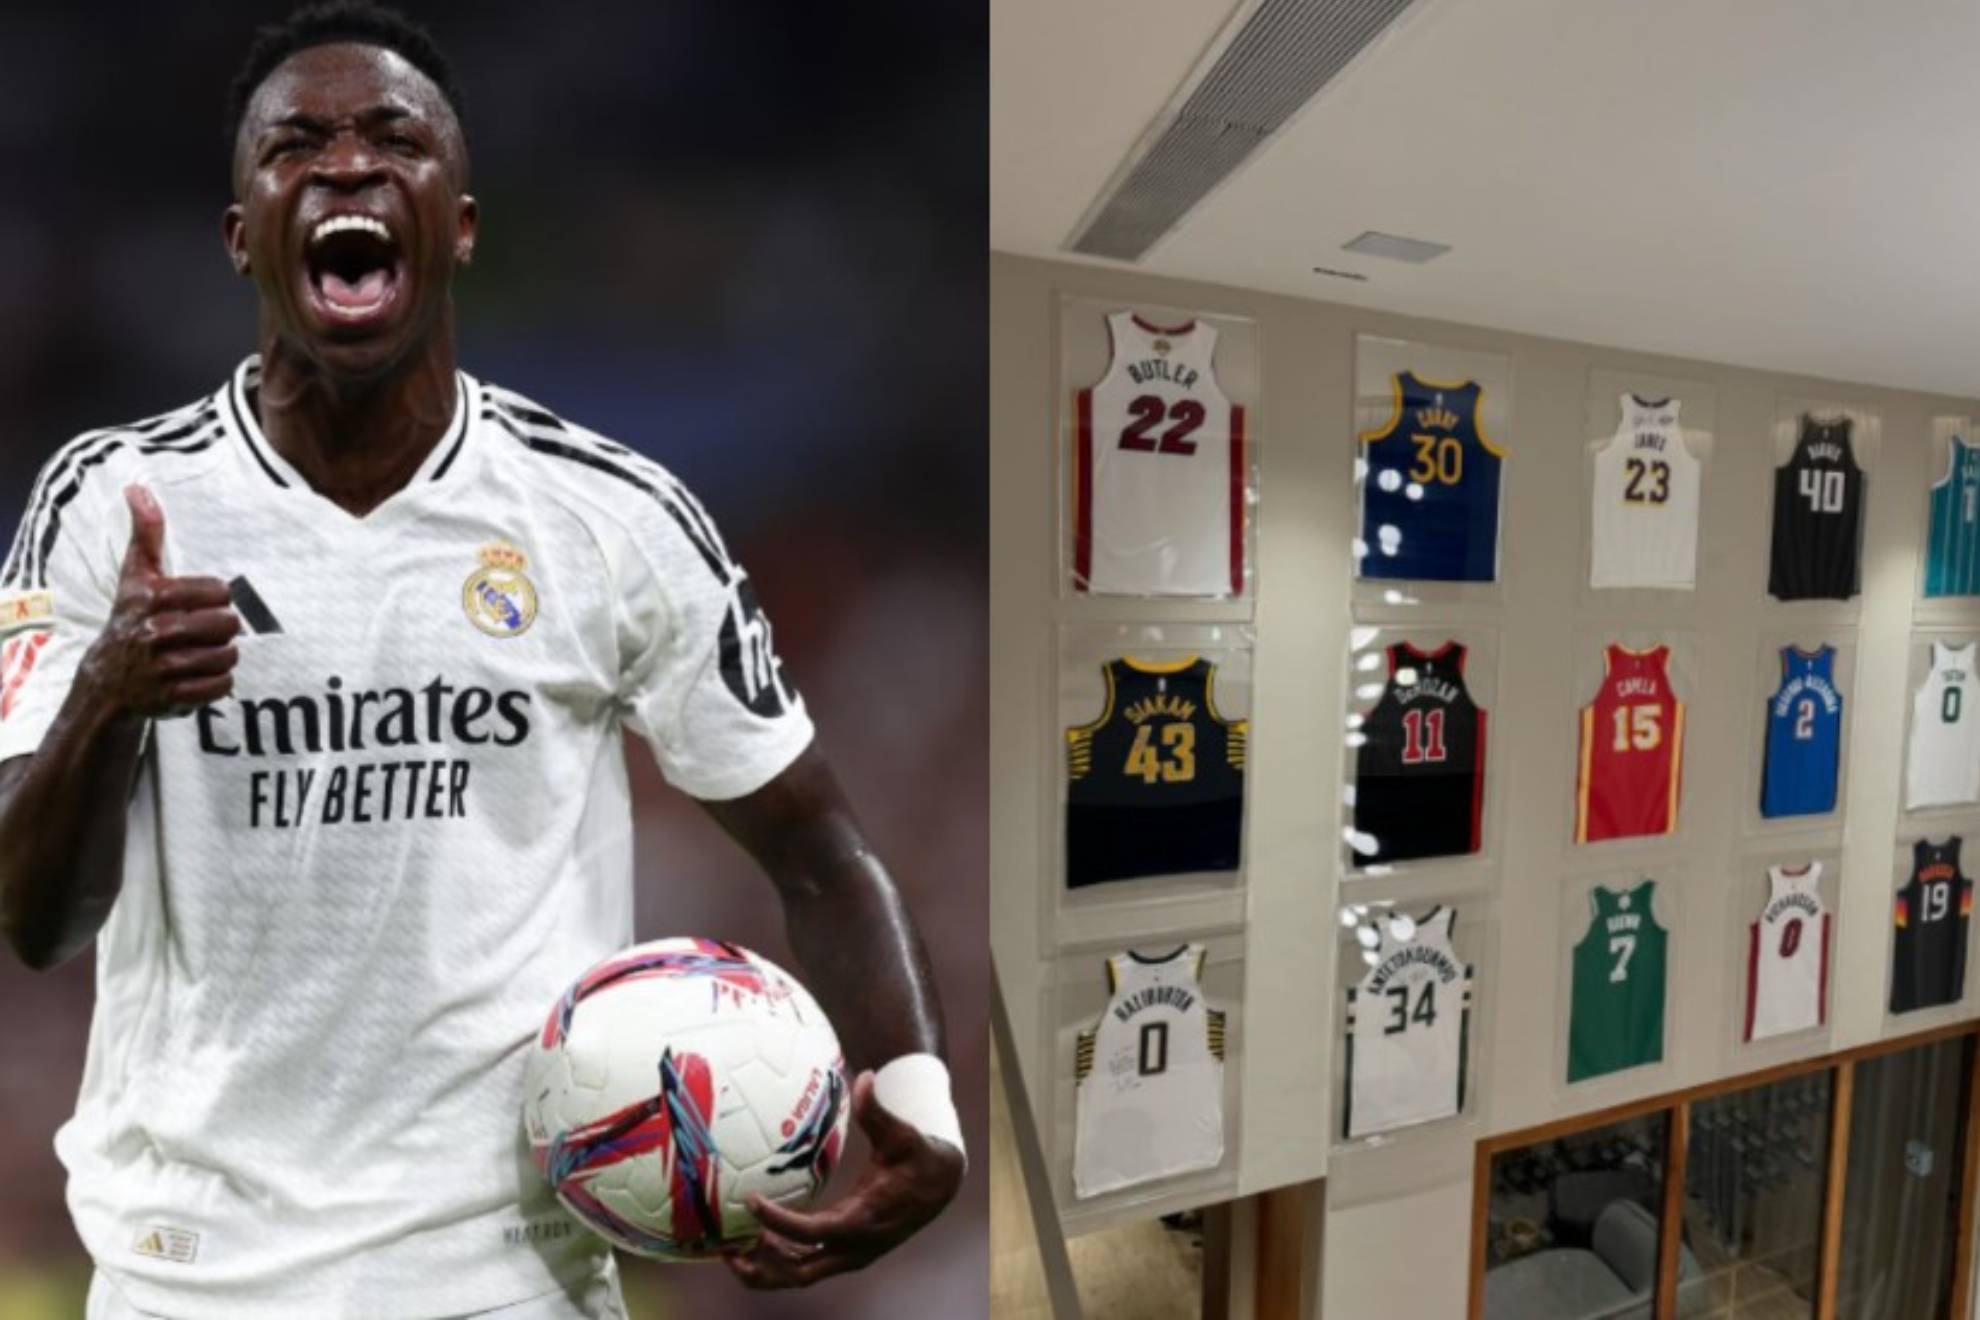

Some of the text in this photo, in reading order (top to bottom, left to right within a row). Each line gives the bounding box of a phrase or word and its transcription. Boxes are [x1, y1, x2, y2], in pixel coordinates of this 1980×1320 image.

[1127, 358, 1199, 390] BUTLER
[1117, 394, 1206, 456] 22
[1409, 432, 1463, 485] 30
[1624, 457, 1671, 503] 23
[1799, 468, 1846, 512] 40
[196, 673, 533, 757] Emirates
[1123, 693, 1197, 724] SIAKAM
[1613, 703, 1663, 752] 15
[1796, 699, 1815, 738] 2
[1942, 686, 1962, 724] 0
[1123, 721, 1196, 785] 43
[1401, 707, 1447, 764] 11
[249, 758, 471, 829] FLY BETTER
[1922, 881, 1949, 922] 19
[1609, 934, 1637, 983] 7
[1778, 917, 1803, 957] 0
[1383, 979, 1437, 1034] 34
[1138, 1020, 1169, 1077] 0
